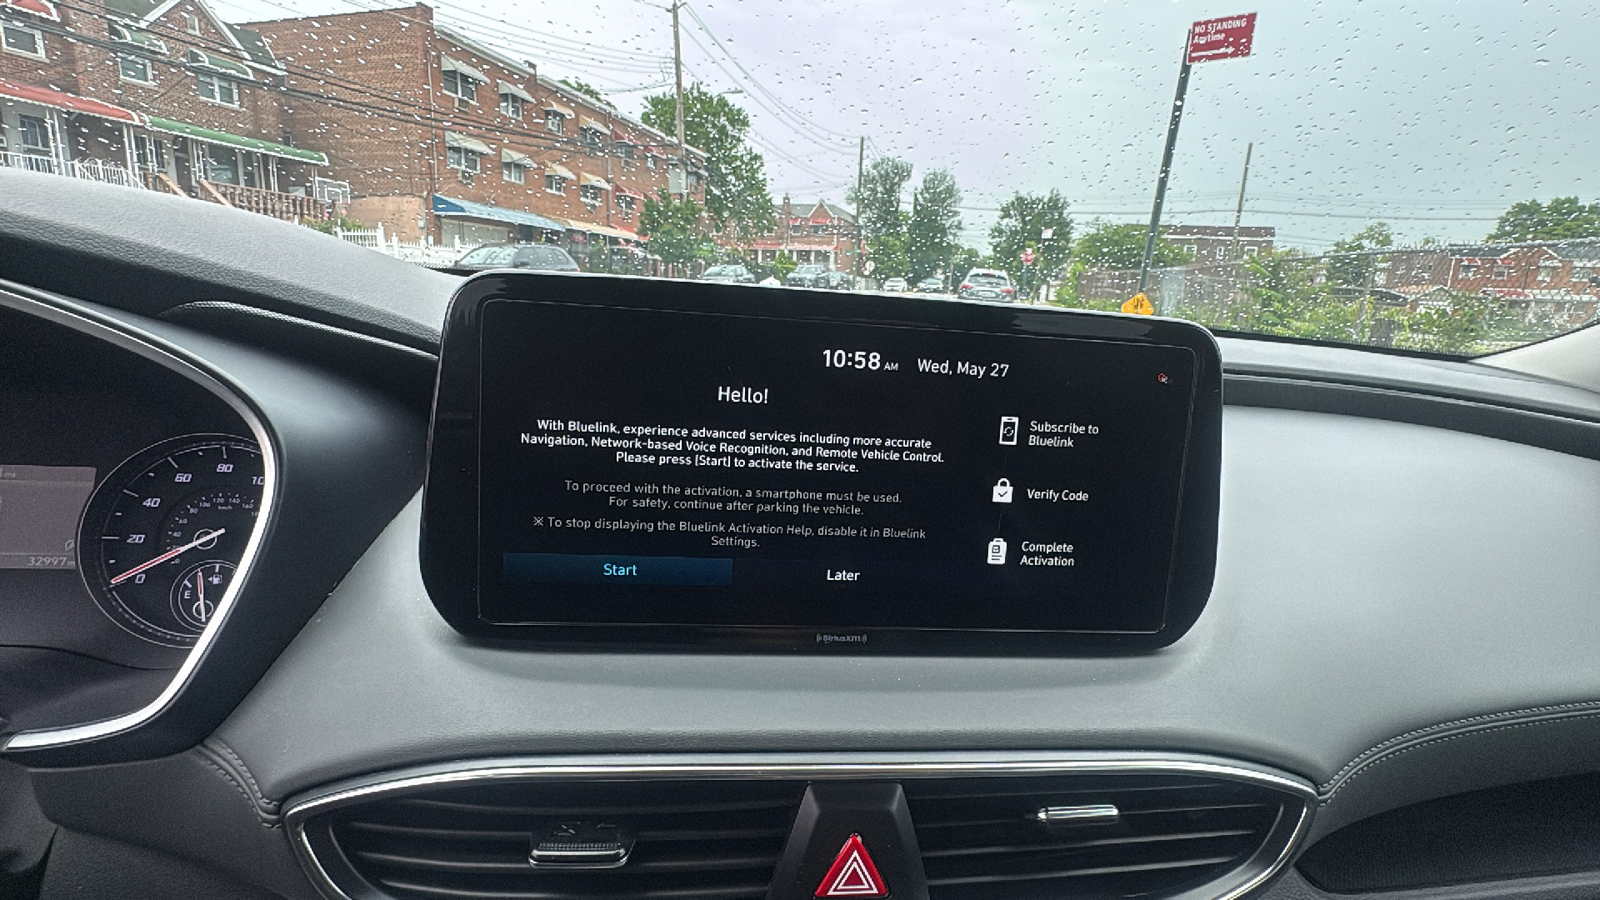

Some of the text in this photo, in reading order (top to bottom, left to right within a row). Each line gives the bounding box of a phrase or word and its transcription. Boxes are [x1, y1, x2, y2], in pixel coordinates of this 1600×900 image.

[1194, 18, 1247, 34] NO STANDING
[823, 349, 899, 372] 10:58 AM
[918, 358, 1010, 379] Wed, May 27
[718, 386, 768, 404] Hello!
[537, 419, 932, 448] With Bluelink, experience advanced services including more accurate
[1030, 420, 1098, 434] Subscribe to
[1029, 434, 1073, 447] Bluelink
[521, 433, 944, 462] Navigation, Network-based Voice Recognition, and Remote Vehicle Control.
[216, 463, 234, 473] 80
[617, 451, 858, 472] Please press [Start] to activate the service.
[174, 473, 193, 483] 60
[252, 476, 265, 486] 10
[565, 480, 901, 503] To proceed with the activation, a smartphone must be used.
[1027, 488, 1088, 502] Verify Code
[142, 497, 161, 508] 40
[609, 496, 863, 515] For safety, continue after parking the vehicle.
[548, 517, 562, 527] To
[566, 519, 590, 530] stop
[595, 519, 653, 532] displaying
[658, 521, 675, 531] the
[680, 521, 725, 532] Bluelink
[728, 523, 783, 534] Activation
[787, 525, 814, 537] Help,
[818, 526, 857, 536] disable
[860, 527, 867, 537] it
[870, 527, 879, 537] in
[883, 528, 925, 538] Bluelink
[126, 534, 146, 544] 20
[712, 536, 759, 548] Settings.
[1022, 541, 1073, 555] Complete
[28, 556, 67, 566] 32997
[1020, 555, 1074, 566] Activation
[604, 564, 637, 575] Start
[827, 569, 860, 581] Later
[134, 574, 146, 584] 0
[183, 590, 191, 599] E
